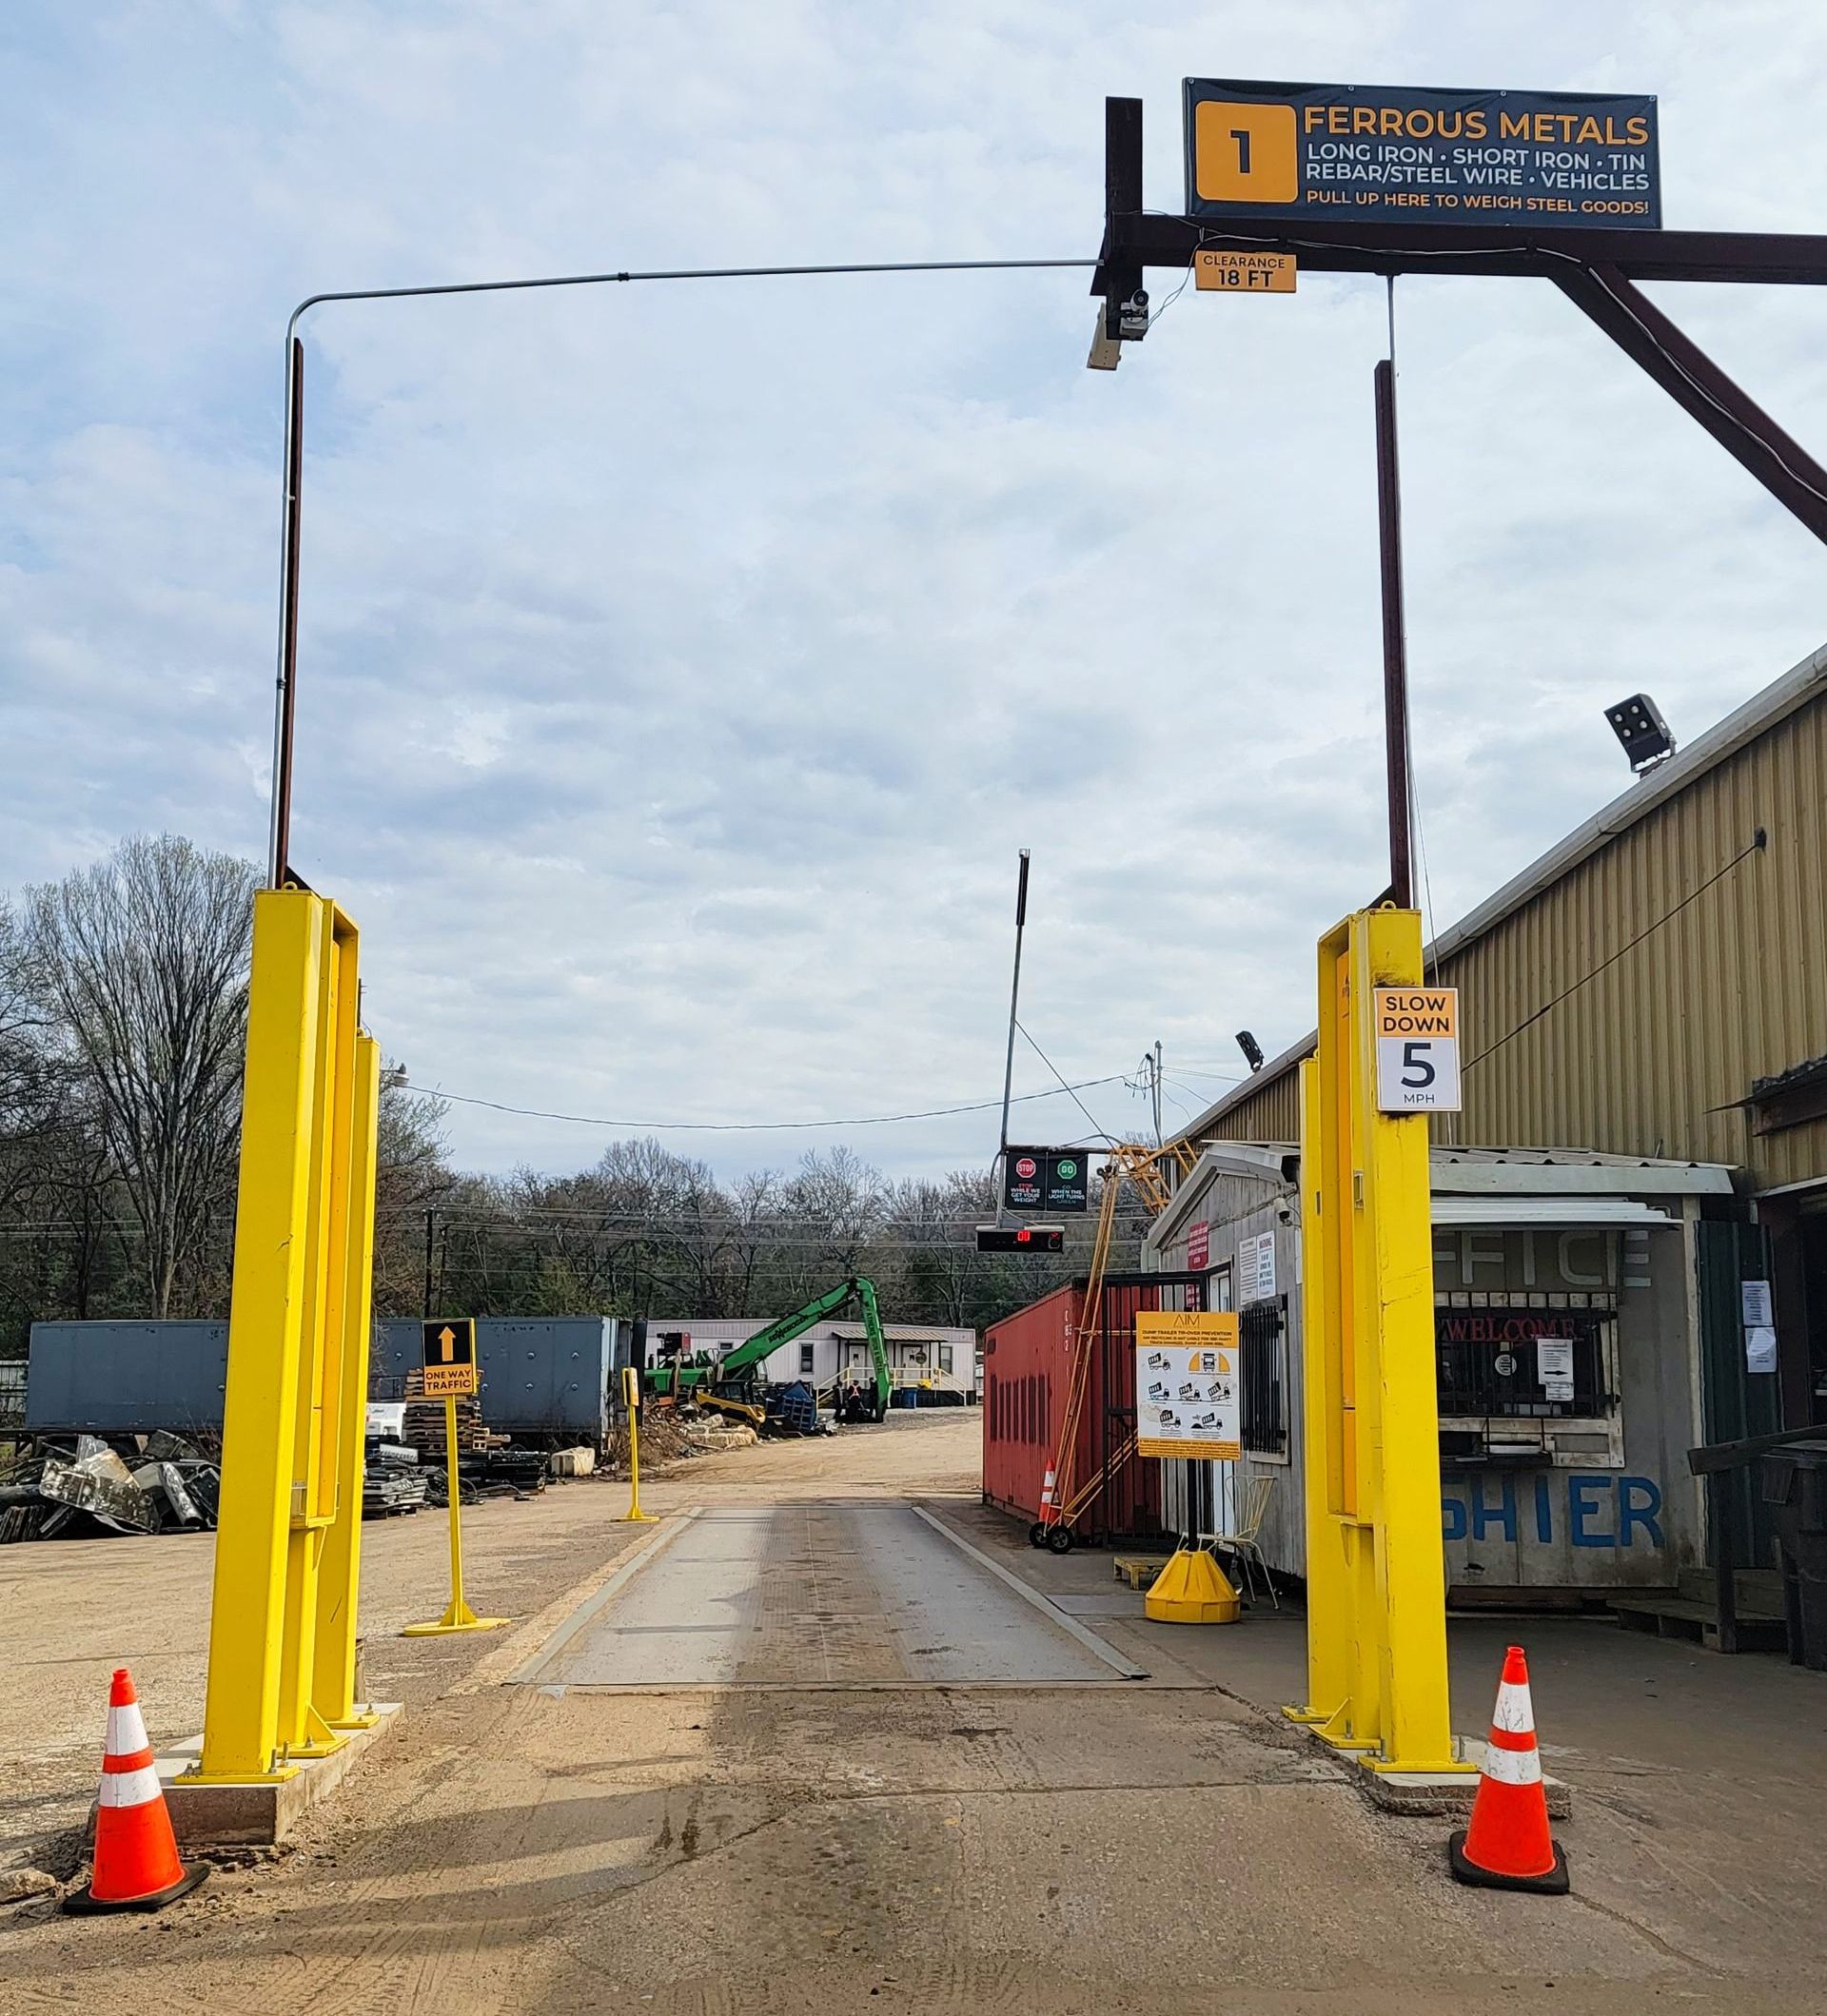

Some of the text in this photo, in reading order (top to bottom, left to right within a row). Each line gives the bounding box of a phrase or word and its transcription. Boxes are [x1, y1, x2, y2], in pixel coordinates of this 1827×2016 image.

[1305, 107, 1649, 146] FERROUS METALS
[1229, 129, 1252, 174] 1
[1308, 143, 1645, 171] LONG IRON SHORT IRON TIN
[1306, 163, 1649, 190] REBAR/STEEL WIRE VEHICLES
[1306, 190, 1649, 214] PULL UP HERE TO WEIGH STEEL GOODS!
[1203, 255, 1286, 269] CLEARANCE
[1218, 269, 1274, 287] 18 FT
[1385, 996, 1446, 1011] SLOW
[1384, 1017, 1449, 1032] DOWN
[1401, 1042, 1436, 1088] 5
[1404, 1094, 1435, 1104] MPH
[1019, 1164, 1033, 1172] STOP
[1434, 1230, 1652, 1287] FICE
[1172, 1314, 1200, 1327] AIM
[1443, 1317, 1576, 1341] WELCOME
[425, 1370, 471, 1380] ONE WAY
[426, 1380, 471, 1391] TRAFFIC
